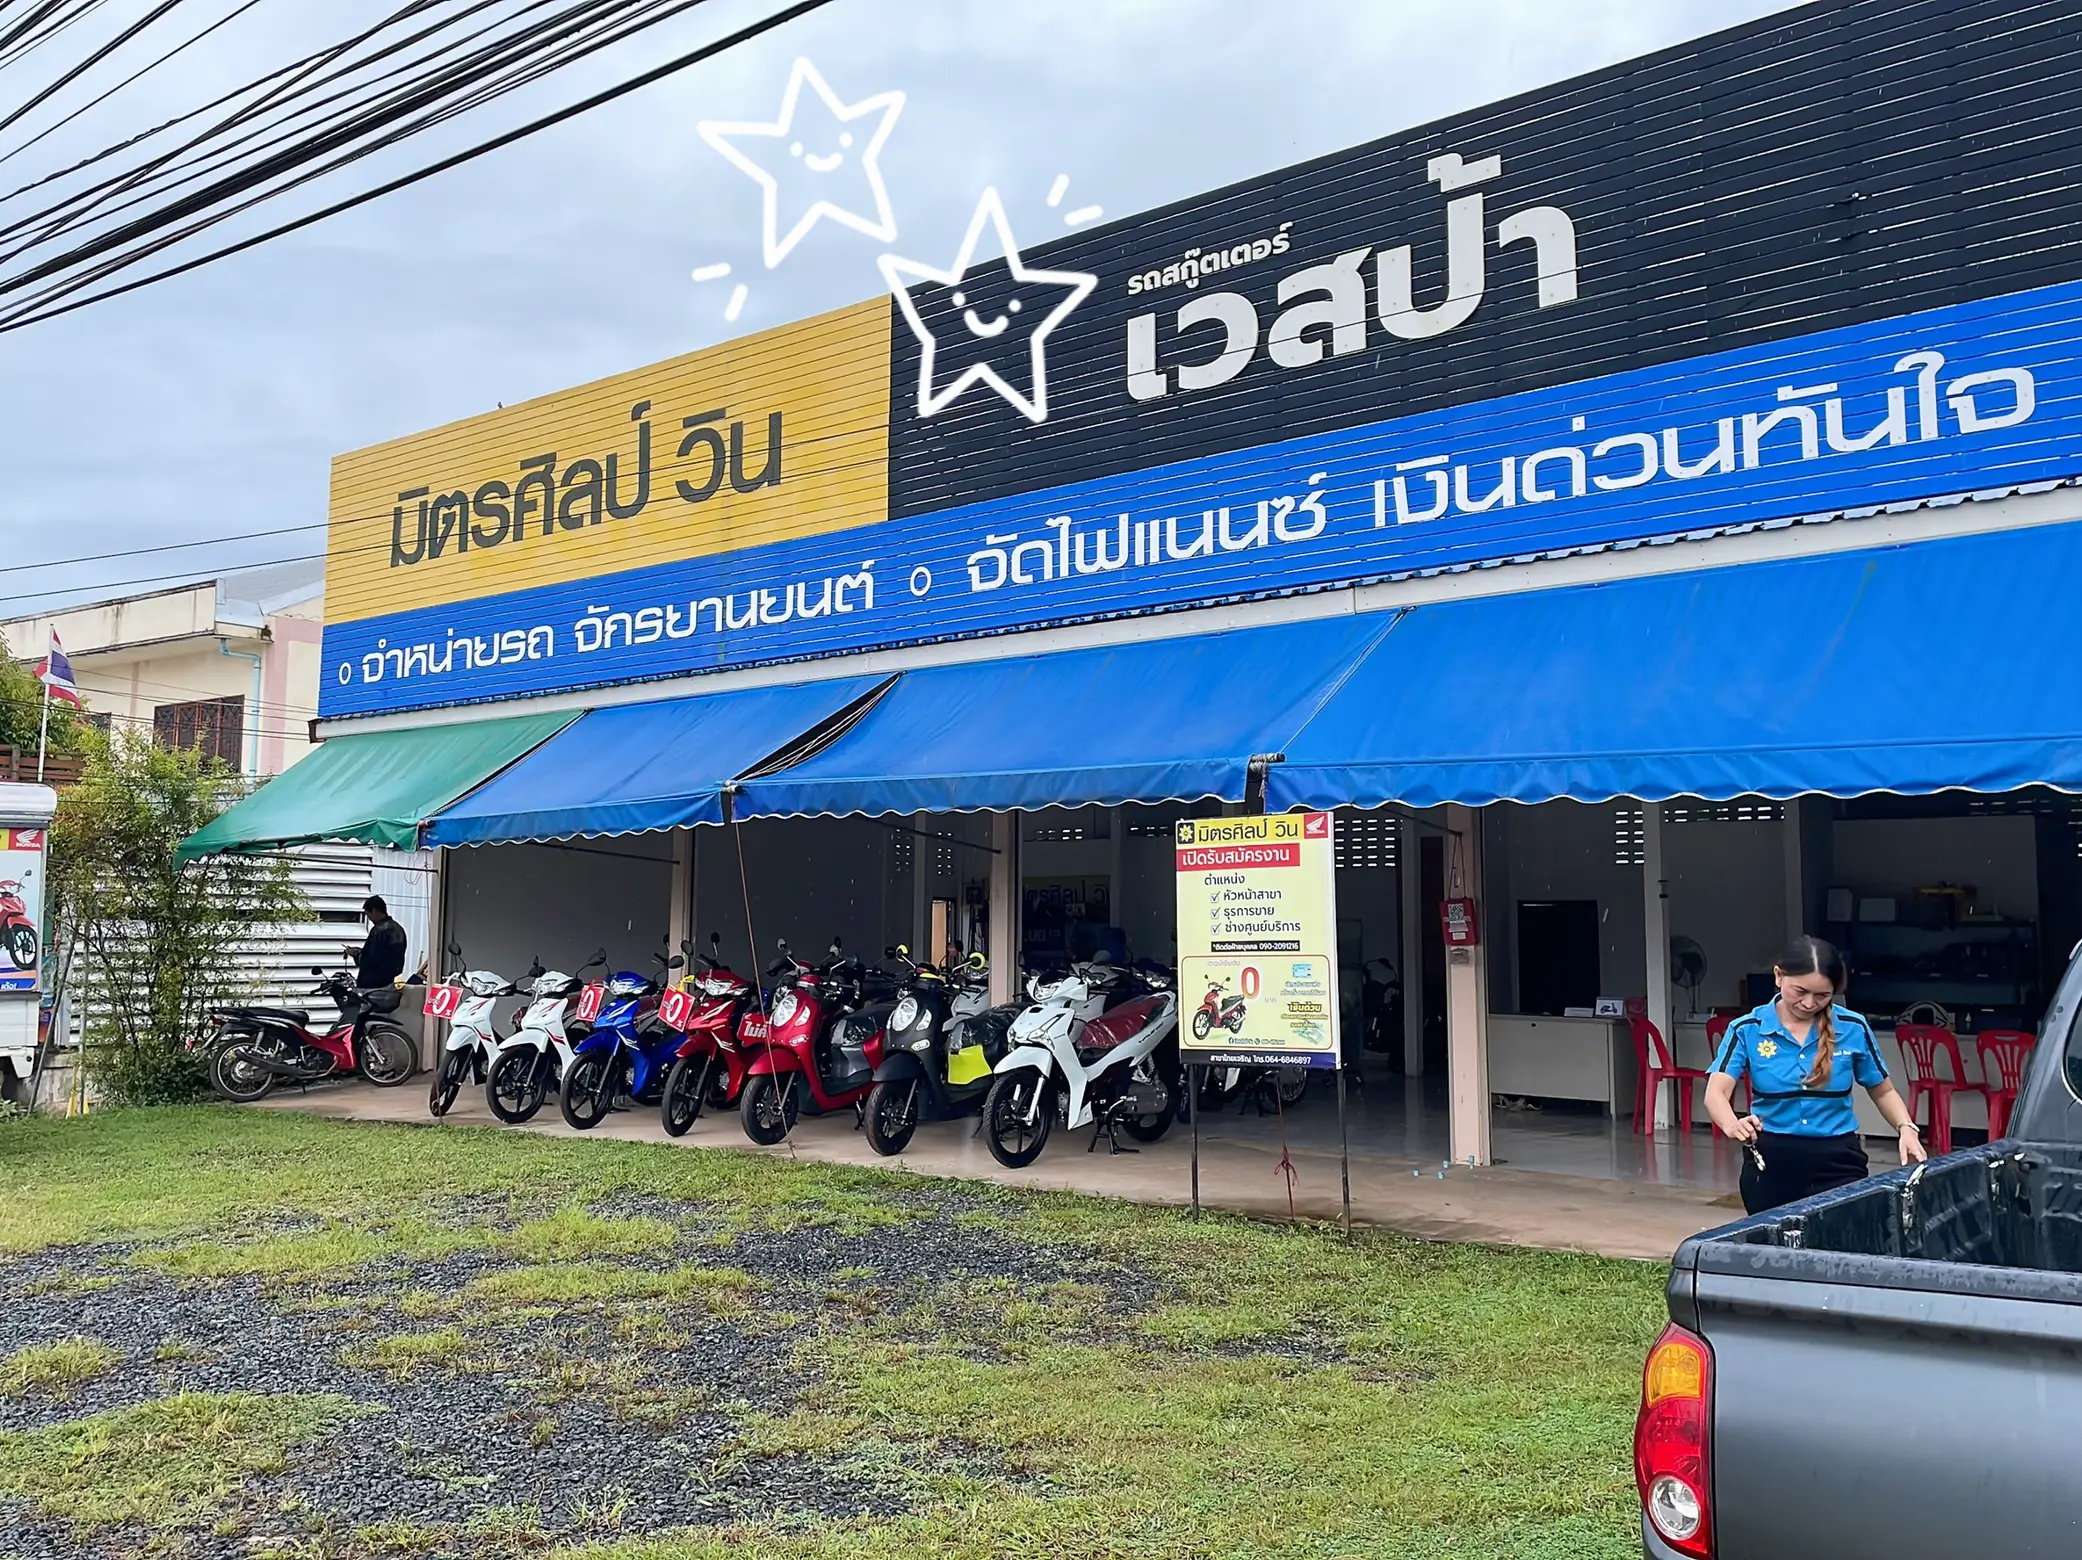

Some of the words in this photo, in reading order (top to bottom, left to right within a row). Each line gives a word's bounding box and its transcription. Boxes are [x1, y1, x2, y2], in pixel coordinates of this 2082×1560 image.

[1127, 221, 1293, 295] รถสกู๊ตเตอร์
[1126, 152, 1578, 402] เวสป้า
[390, 400, 652, 568] มิตรศิลป์
[674, 408, 783, 503] วิน
[966, 471, 1328, 593] จัดไฟแนนซ์
[1373, 351, 2036, 528] เงินด่วนทันใจ
[361, 627, 555, 684] จำหน่ายรถ
[574, 560, 876, 654] จักรยานยนต์
[1198, 818, 1268, 842] มิตรศิลป์
[1275, 820, 1299, 838] วิน
[1182, 847, 1290, 866] เปิดรับสมัครงาน
[1204, 872, 1246, 886] ตำแหน่ง
[1223, 888, 1282, 901] หัวหน้าสาขา
[1223, 906, 1275, 920] ธุรการขาย
[1224, 920, 1301, 935] ช่างศูนย์บริการ
[1241, 966, 1260, 1000] 0
